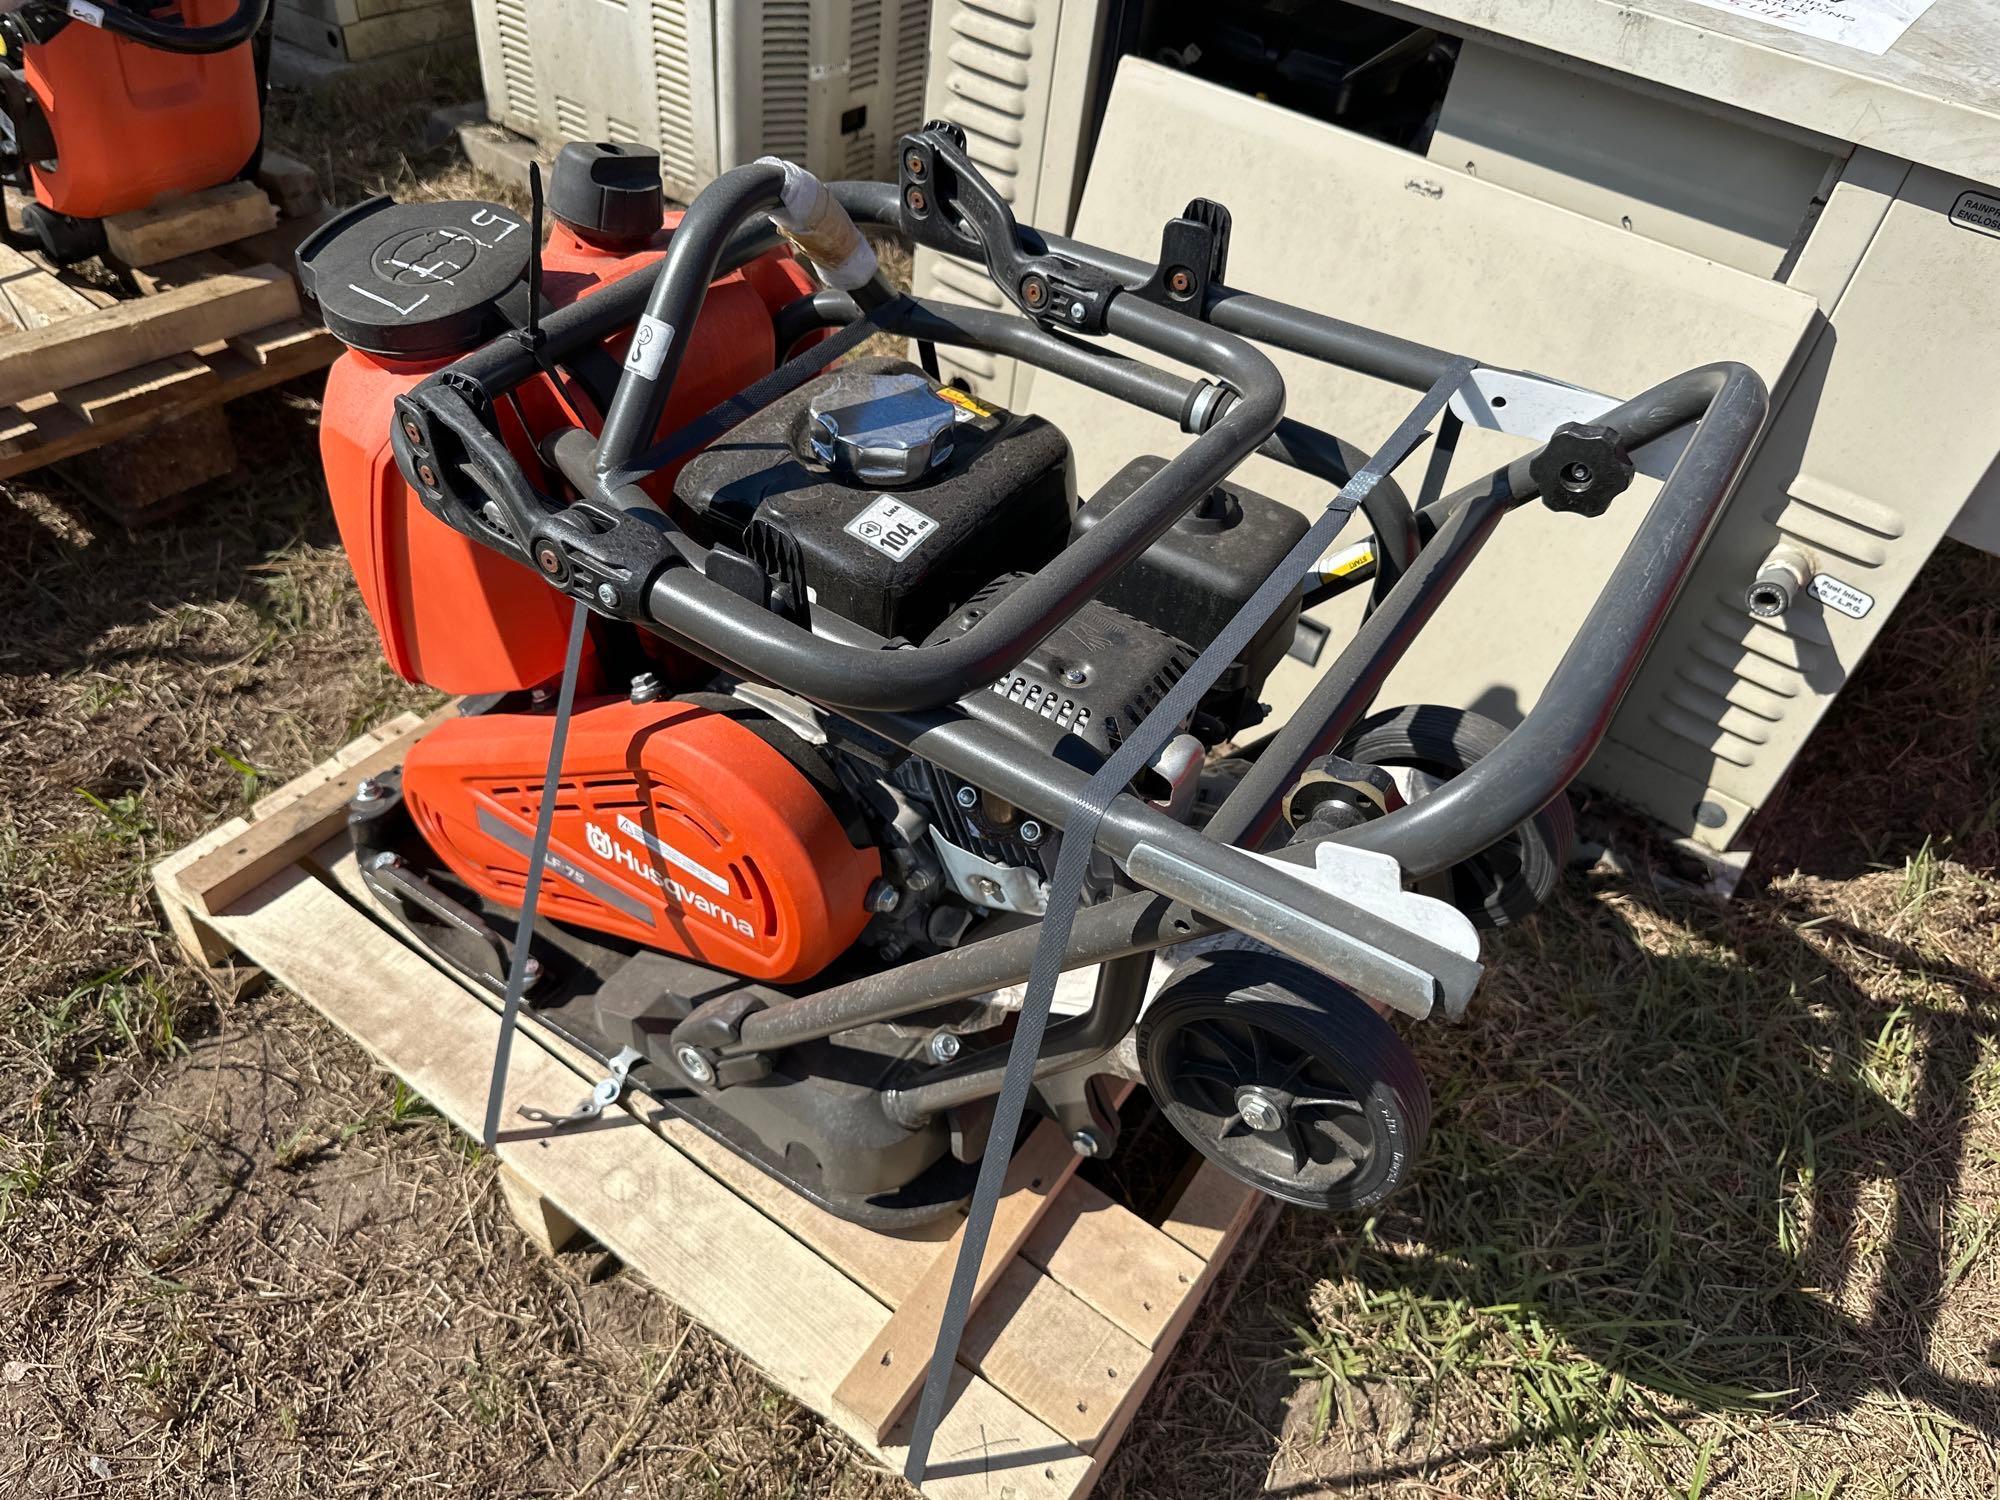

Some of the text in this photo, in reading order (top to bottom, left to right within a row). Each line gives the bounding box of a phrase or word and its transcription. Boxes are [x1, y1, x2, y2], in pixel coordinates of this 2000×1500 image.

[880, 523, 918, 552] 104
[1349, 556, 1368, 569] START
[1822, 581, 1863, 604] Fuel Inlet
[563, 864, 586, 885] 75
[614, 843, 756, 940] Husqvarna
